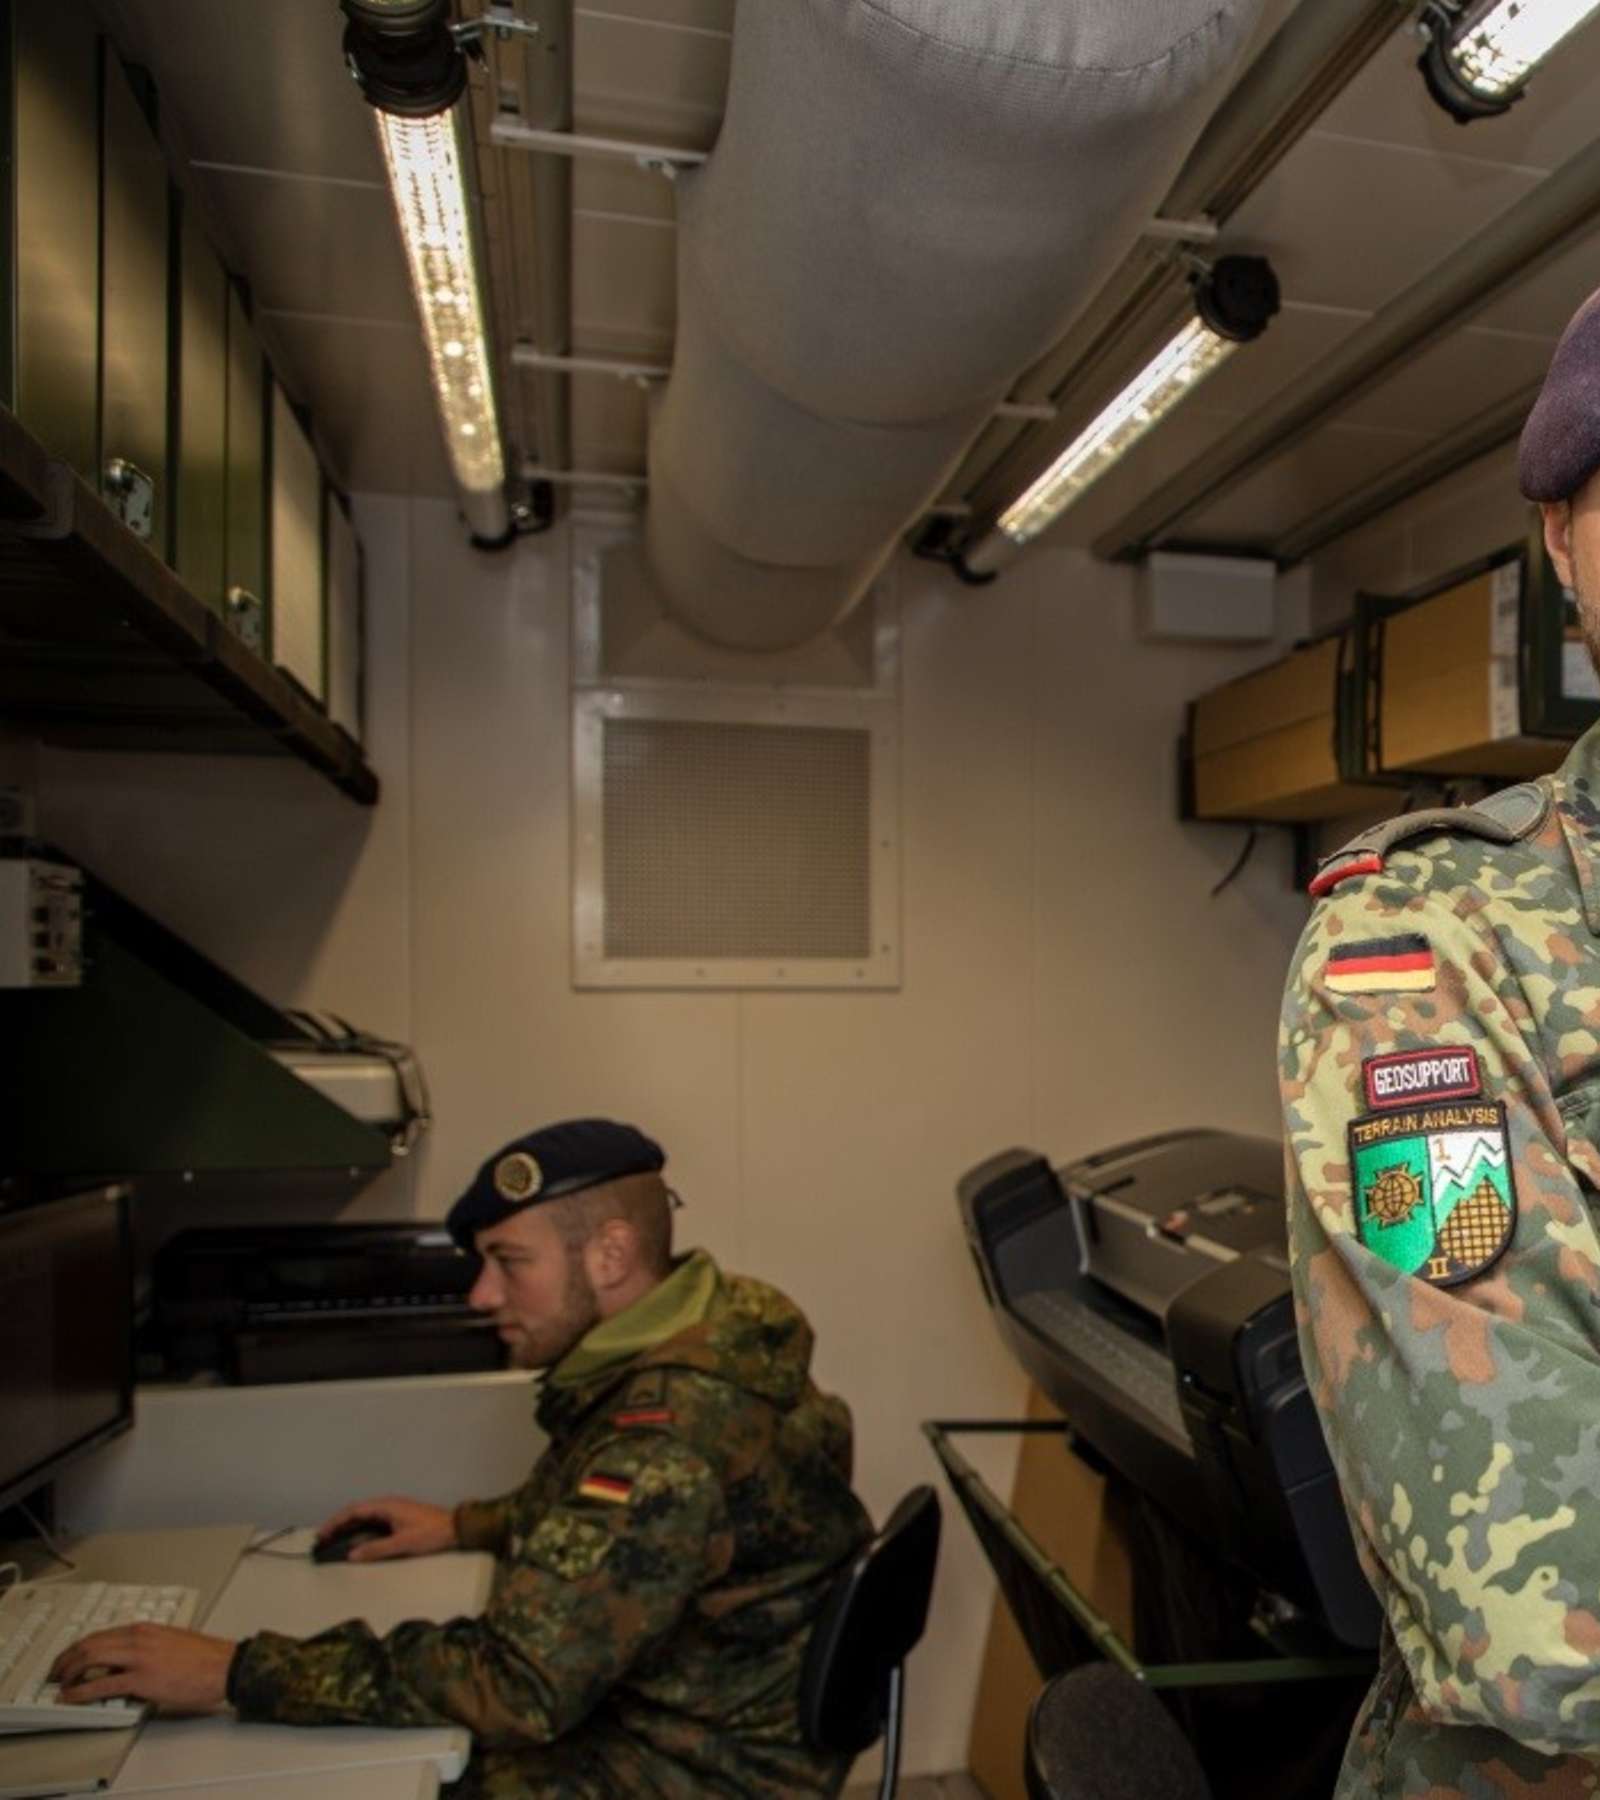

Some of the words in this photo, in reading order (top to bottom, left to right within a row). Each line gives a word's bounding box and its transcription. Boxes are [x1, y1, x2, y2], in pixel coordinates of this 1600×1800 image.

[1375, 1058, 1469, 1095] GEOSUPPORT
[1354, 1113, 1417, 1142] TERRAIN
[1422, 1107, 1499, 1128] ANALYSIS
